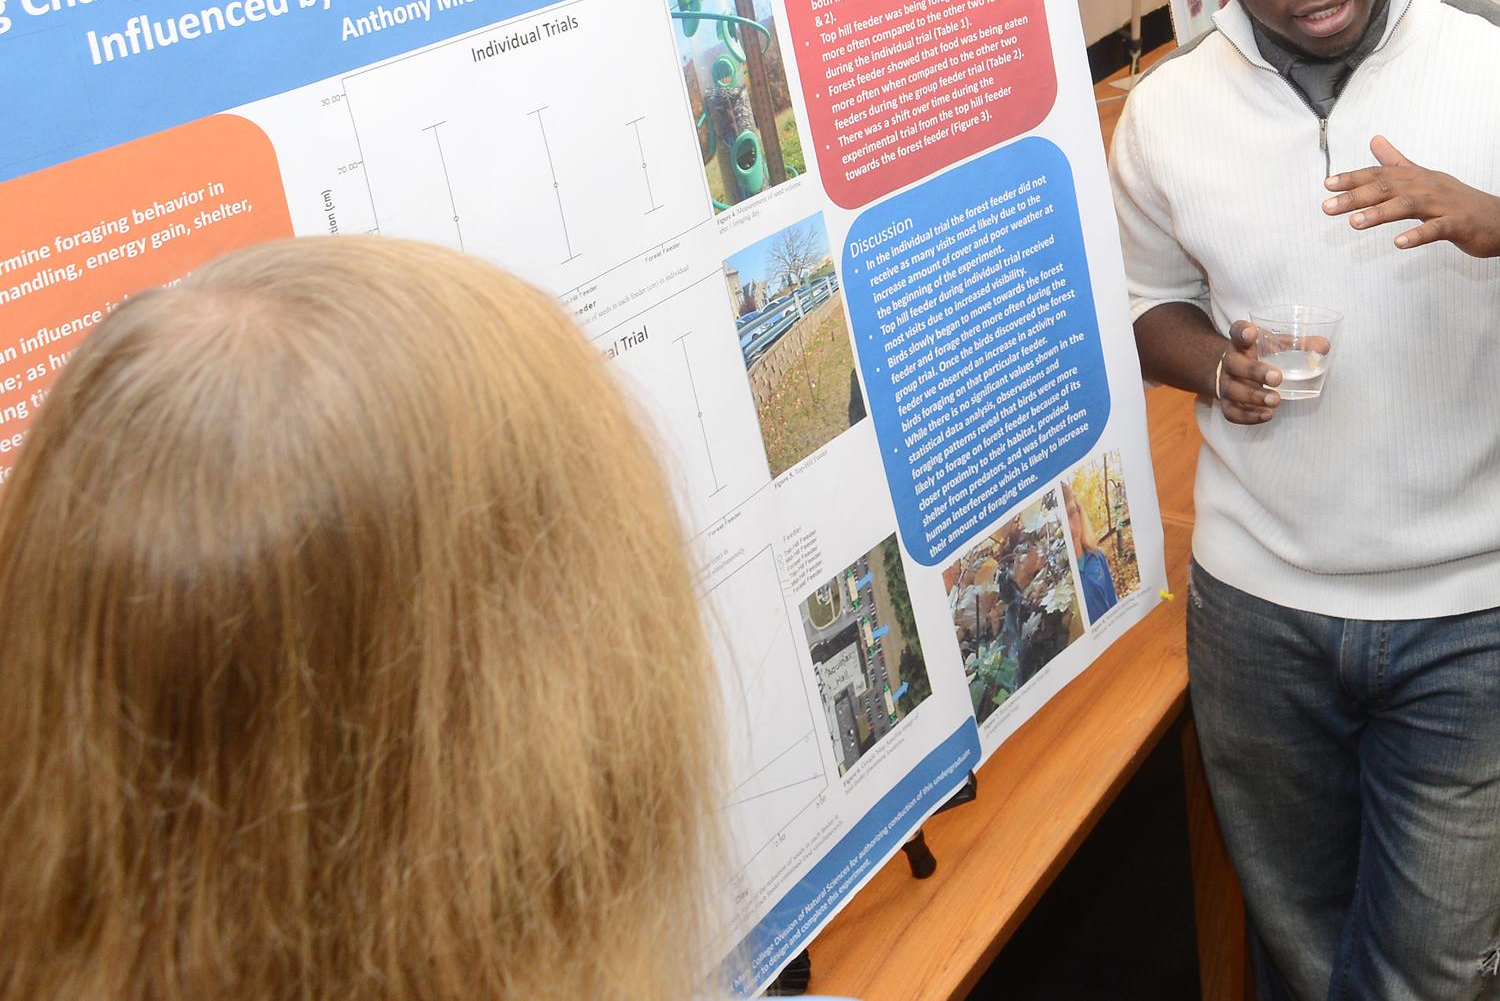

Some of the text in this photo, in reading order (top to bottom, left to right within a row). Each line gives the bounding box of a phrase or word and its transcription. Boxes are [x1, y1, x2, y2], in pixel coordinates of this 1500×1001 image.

[471, 15, 578, 62] Individual Trials
[815, 11, 837, 27] & 2).
[820, 31, 837, 44] Top
[838, 23, 852, 38] hill
[853, 15, 883, 32] feeder
[885, 8, 903, 21] was
[903, 0, 927, 14] being
[337, 161, 358, 175] 20.00
[54, 217, 130, 253] foraging
[132, 189, 204, 225] behavior
[208, 182, 224, 197] in
[321, 189, 336, 212] (cm)
[866, 175, 1047, 270] In the individual trial the forest feeder did not
[86, 237, 146, 269] energy
[151, 223, 191, 249] gain,
[194, 199, 252, 229] shelter,
[850, 218, 913, 258] Discussion
[20, 310, 103, 355] influence
[621, 325, 649, 351] Trial
[27, 362, 47, 382] as
[752, 748, 970, 969] College Division of Natural Sciences for authorizing conduction of this undergraduate
[761, 859, 872, 975] to design and complete this experiment.
